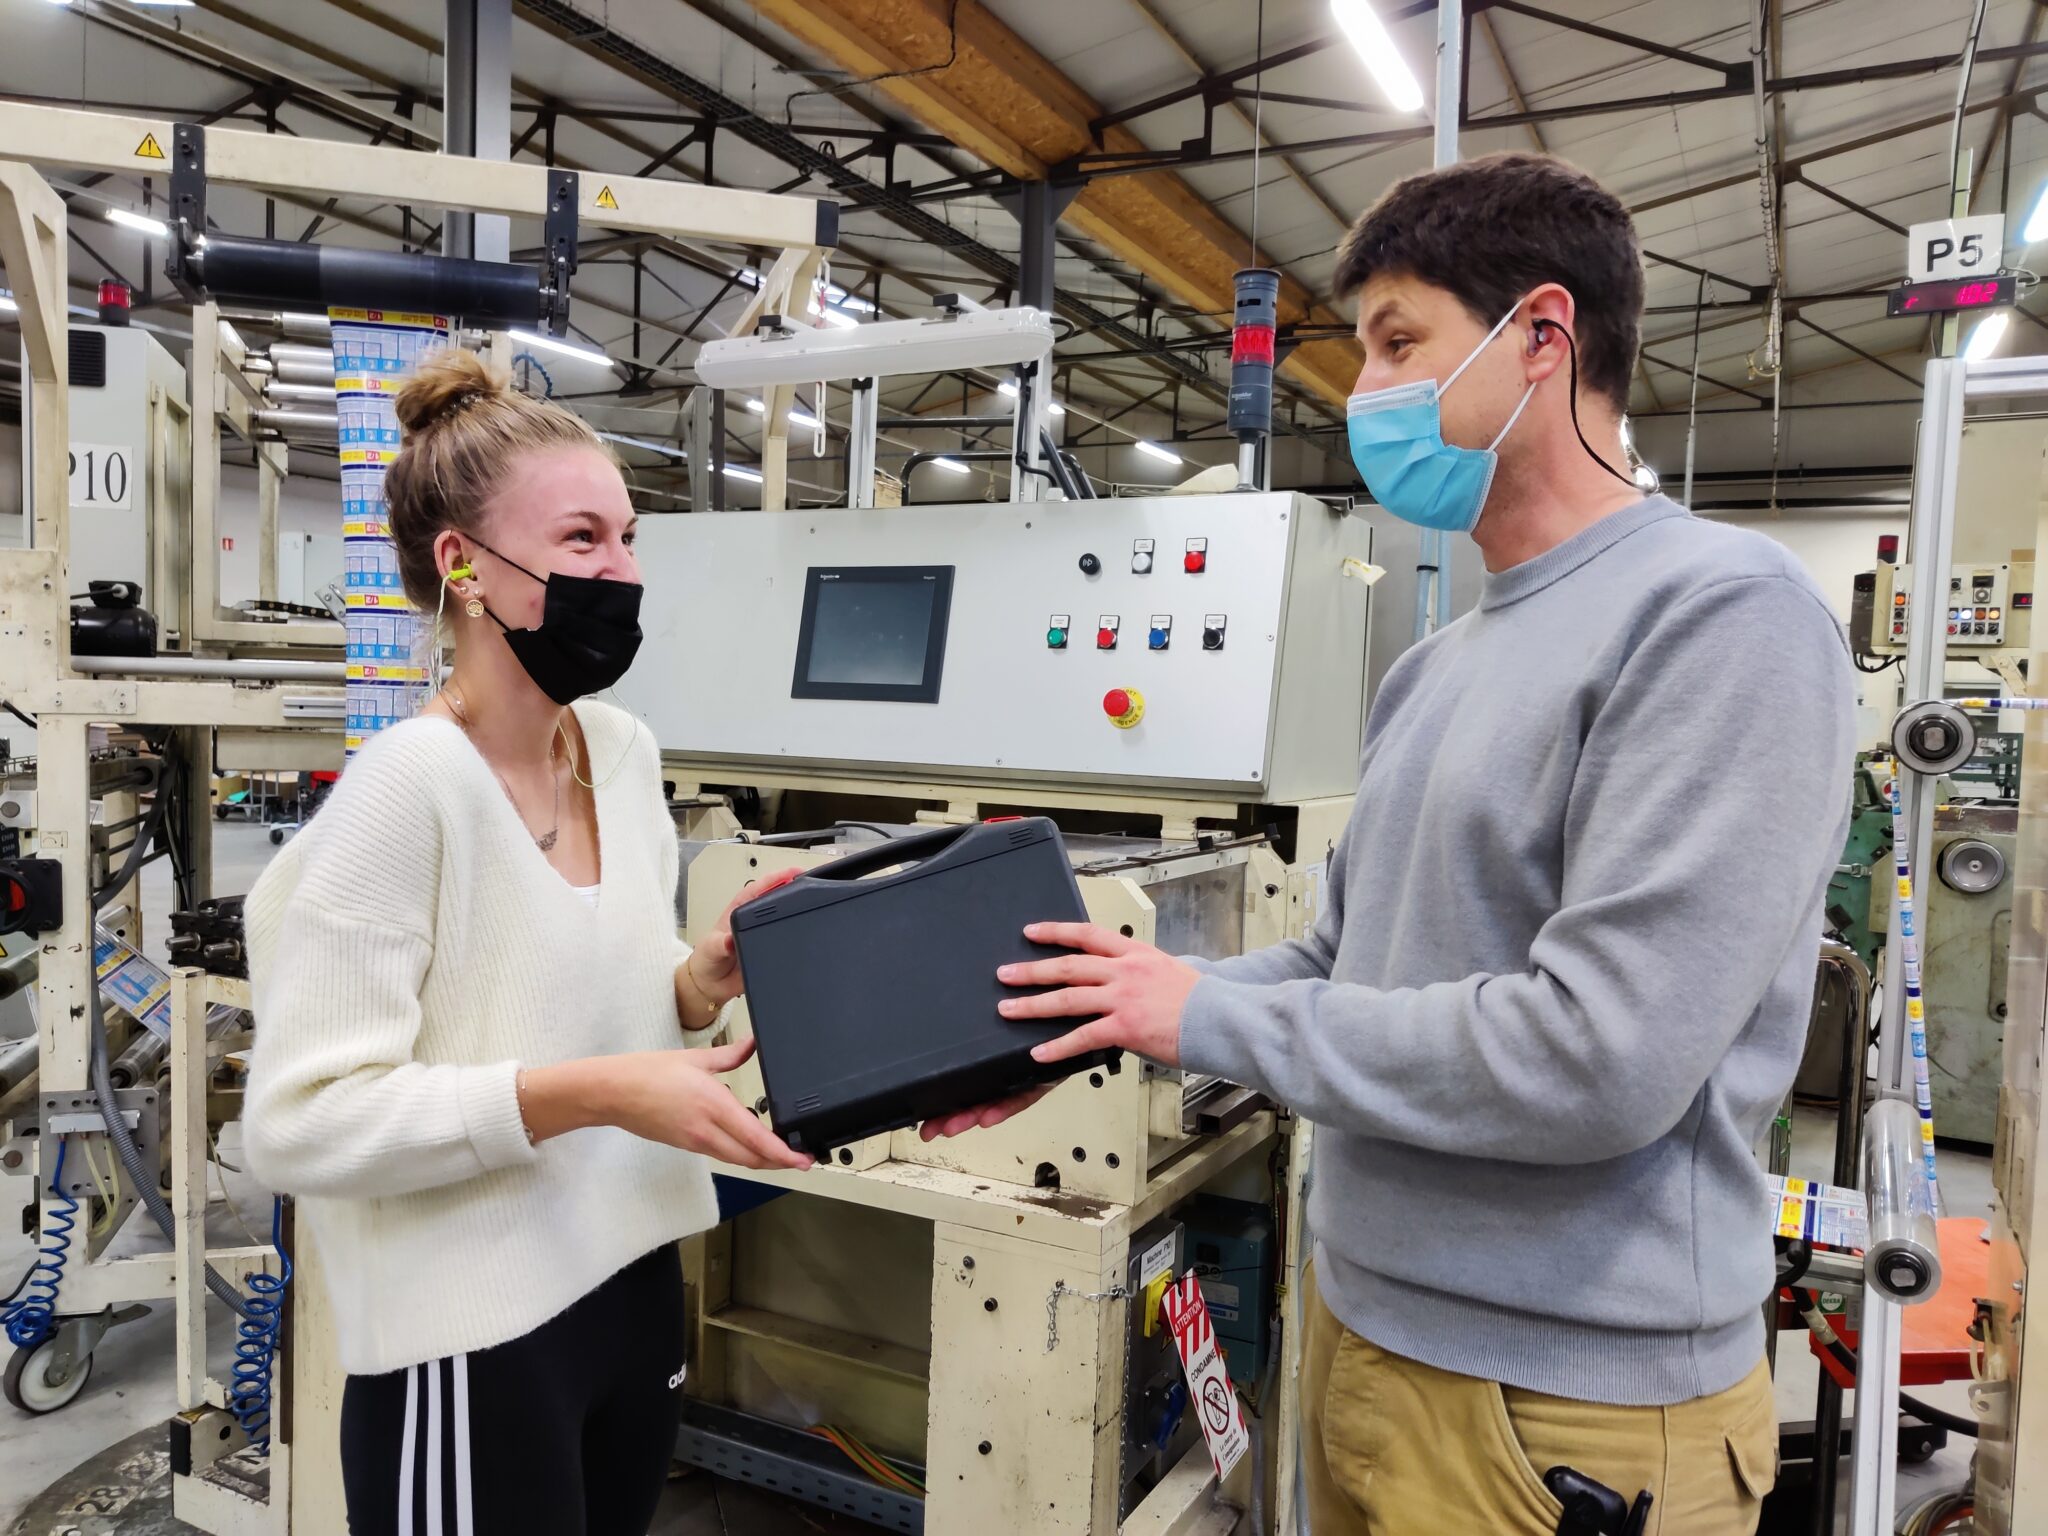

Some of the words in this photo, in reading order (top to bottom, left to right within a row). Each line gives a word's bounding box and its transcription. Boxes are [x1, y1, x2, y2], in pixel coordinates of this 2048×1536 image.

[1926, 234, 1984, 273] P5
[69, 451, 127, 503] 10
[1174, 1299, 1202, 1333] ATTENTION
